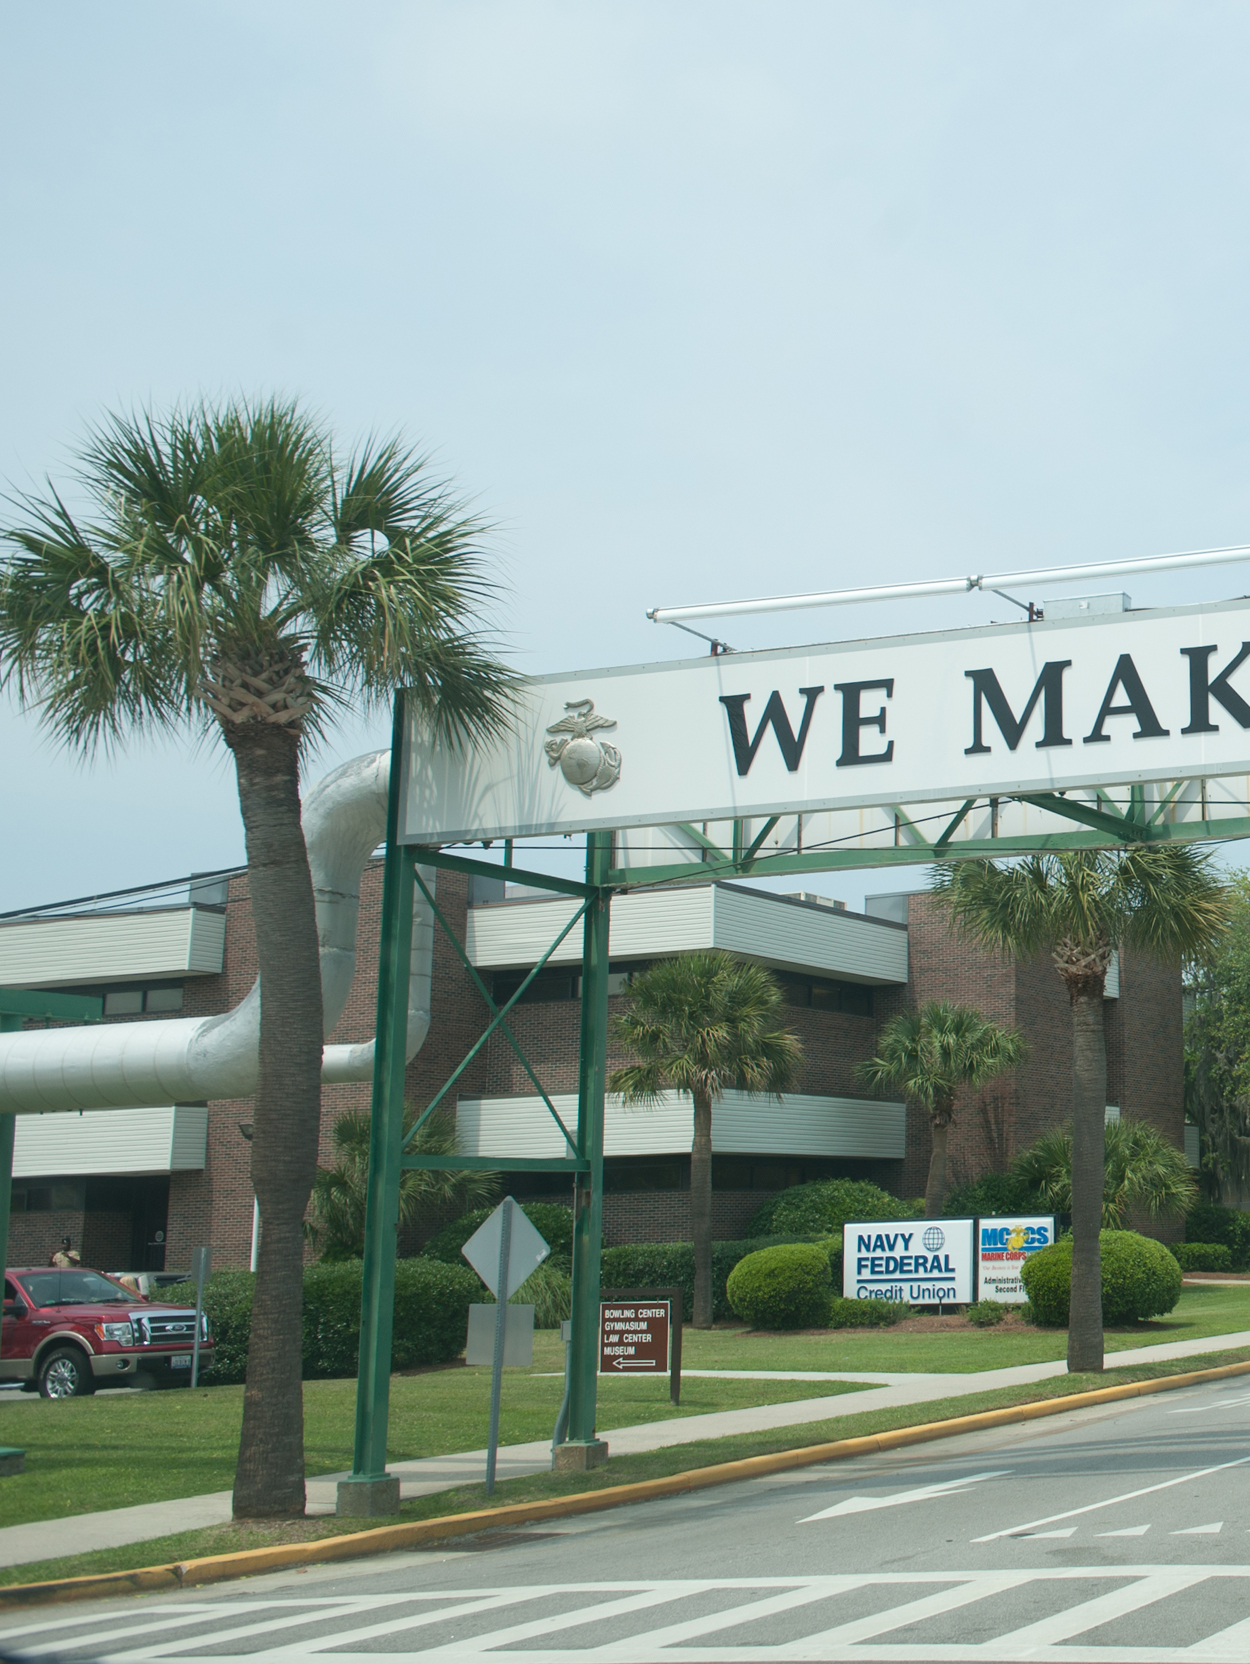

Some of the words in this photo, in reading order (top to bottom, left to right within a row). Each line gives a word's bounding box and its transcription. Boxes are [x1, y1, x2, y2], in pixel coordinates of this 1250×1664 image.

[718, 677, 895, 777] WE
[857, 1232, 914, 1253] NAVY
[981, 1251, 1005, 1261] MARINE
[1005, 1251, 1027, 1261] CORPS
[857, 1253, 956, 1276] FEDERAL
[984, 1276, 1022, 1285] Administrativ
[857, 1284, 904, 1300] Credit
[909, 1283, 956, 1300] Union
[995, 1285, 1018, 1293] Second
[604, 1309, 635, 1319] BOWLING
[638, 1309, 666, 1318] CENTER
[604, 1321, 648, 1331] GYMNASIUM
[604, 1334, 620, 1343] LAW
[623, 1333, 652, 1343] CENTER
[603, 1346, 635, 1356] MUSEUM
